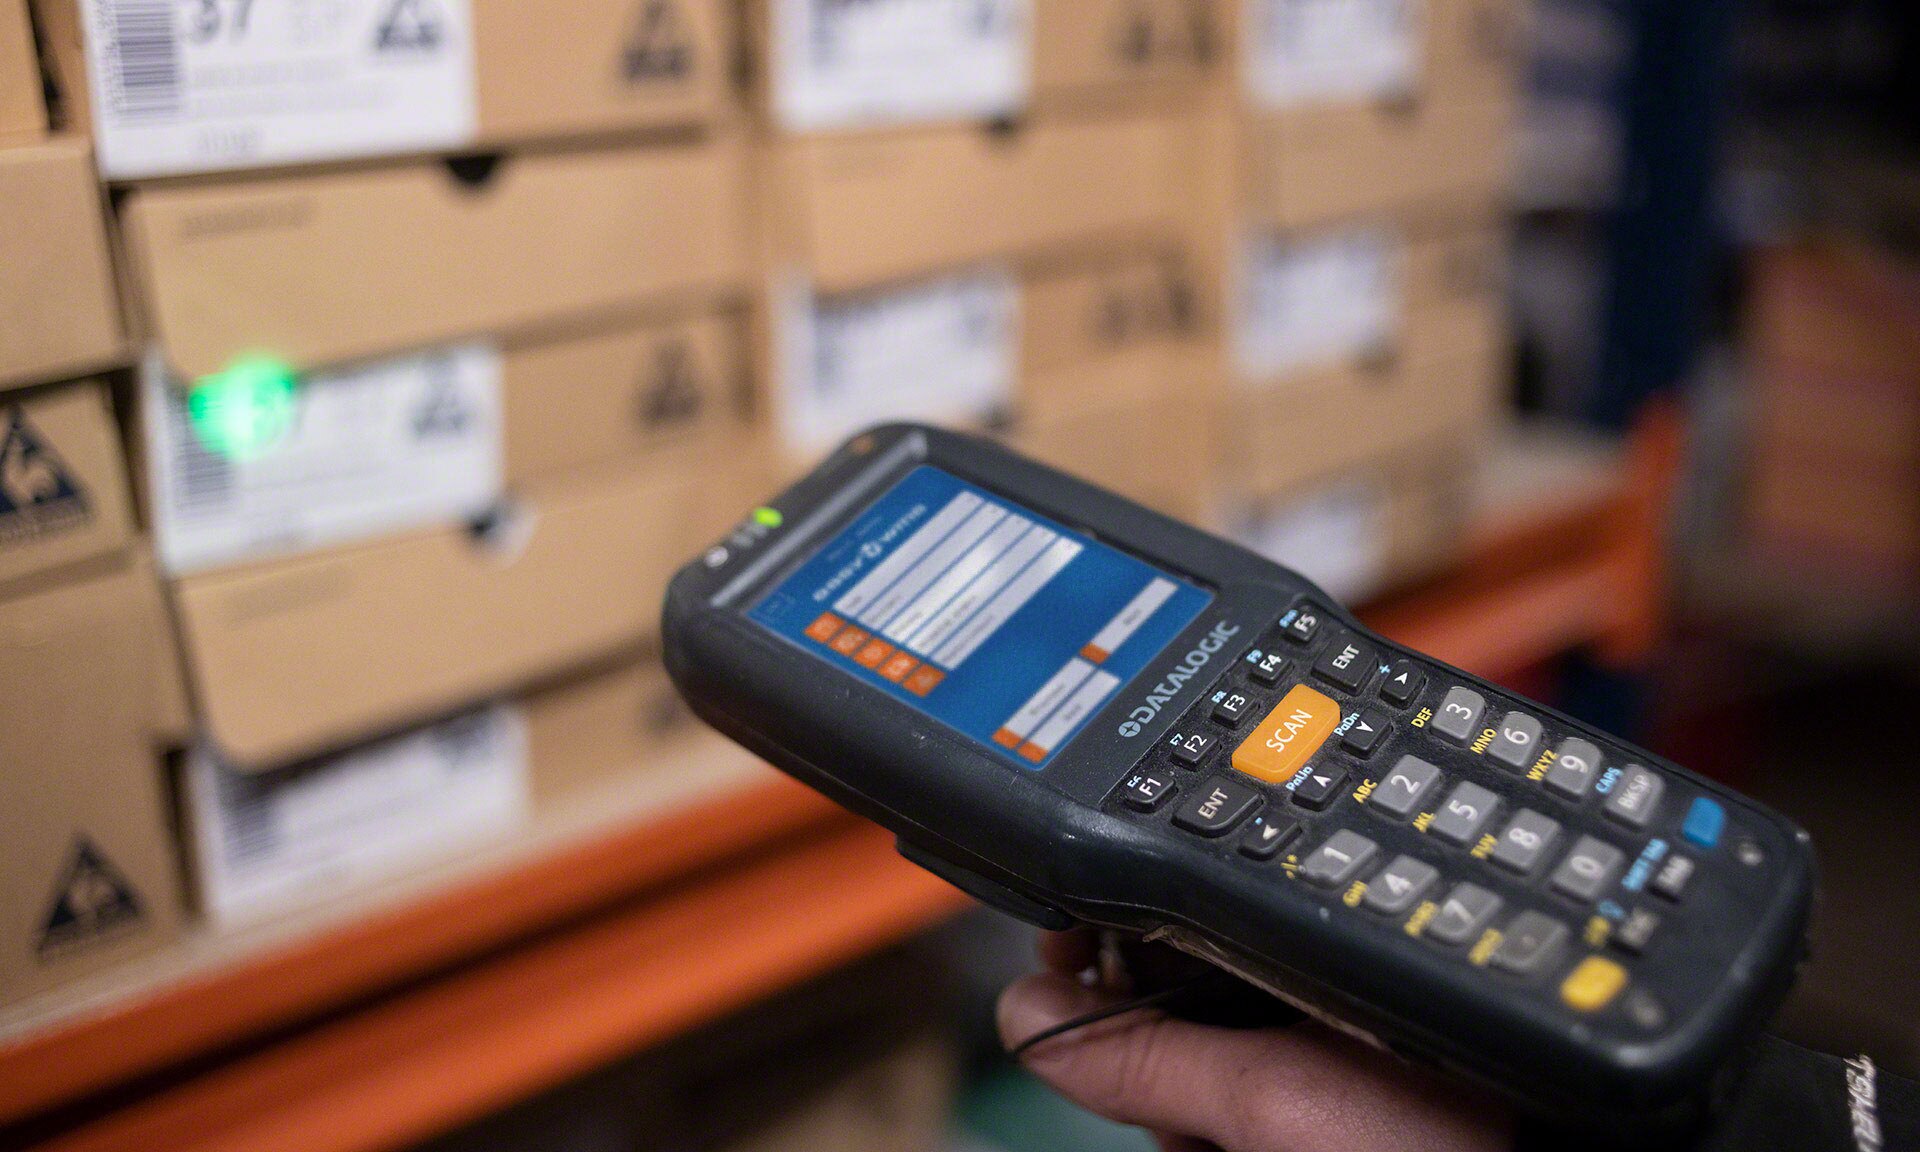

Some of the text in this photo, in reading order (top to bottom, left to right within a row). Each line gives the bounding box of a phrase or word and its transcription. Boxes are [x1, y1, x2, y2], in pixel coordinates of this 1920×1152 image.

[1293, 613, 1317, 633] F5
[1246, 649, 1263, 664] F9
[1259, 654, 1282, 673] F4
[1331, 644, 1360, 670] ENT
[1128, 619, 1241, 725] DATALOGIC
[1223, 694, 1246, 712] F3
[1445, 703, 1473, 720] 3
[1410, 706, 1434, 729] DEF
[1170, 733, 1184, 746] F7
[1265, 708, 1314, 753] SCAN
[1503, 727, 1530, 745] 6
[1183, 734, 1208, 753] F2
[1470, 728, 1498, 755] MNO
[1526, 749, 1559, 781] WXYZ
[1559, 754, 1589, 774] 9
[1138, 777, 1162, 797] F1
[1390, 774, 1421, 794] 2
[1595, 766, 1624, 794] CAPS
[1352, 778, 1378, 804] ABC
[1617, 774, 1649, 810] BKSP
[1197, 787, 1229, 820] ENT
[1448, 800, 1479, 821] 5
[1412, 811, 1437, 833] JKL
[1508, 827, 1542, 848] 8
[1323, 846, 1352, 863] 1
[1570, 855, 1603, 880] 0
[1384, 872, 1413, 895] 4
[1442, 899, 1476, 926] 7
